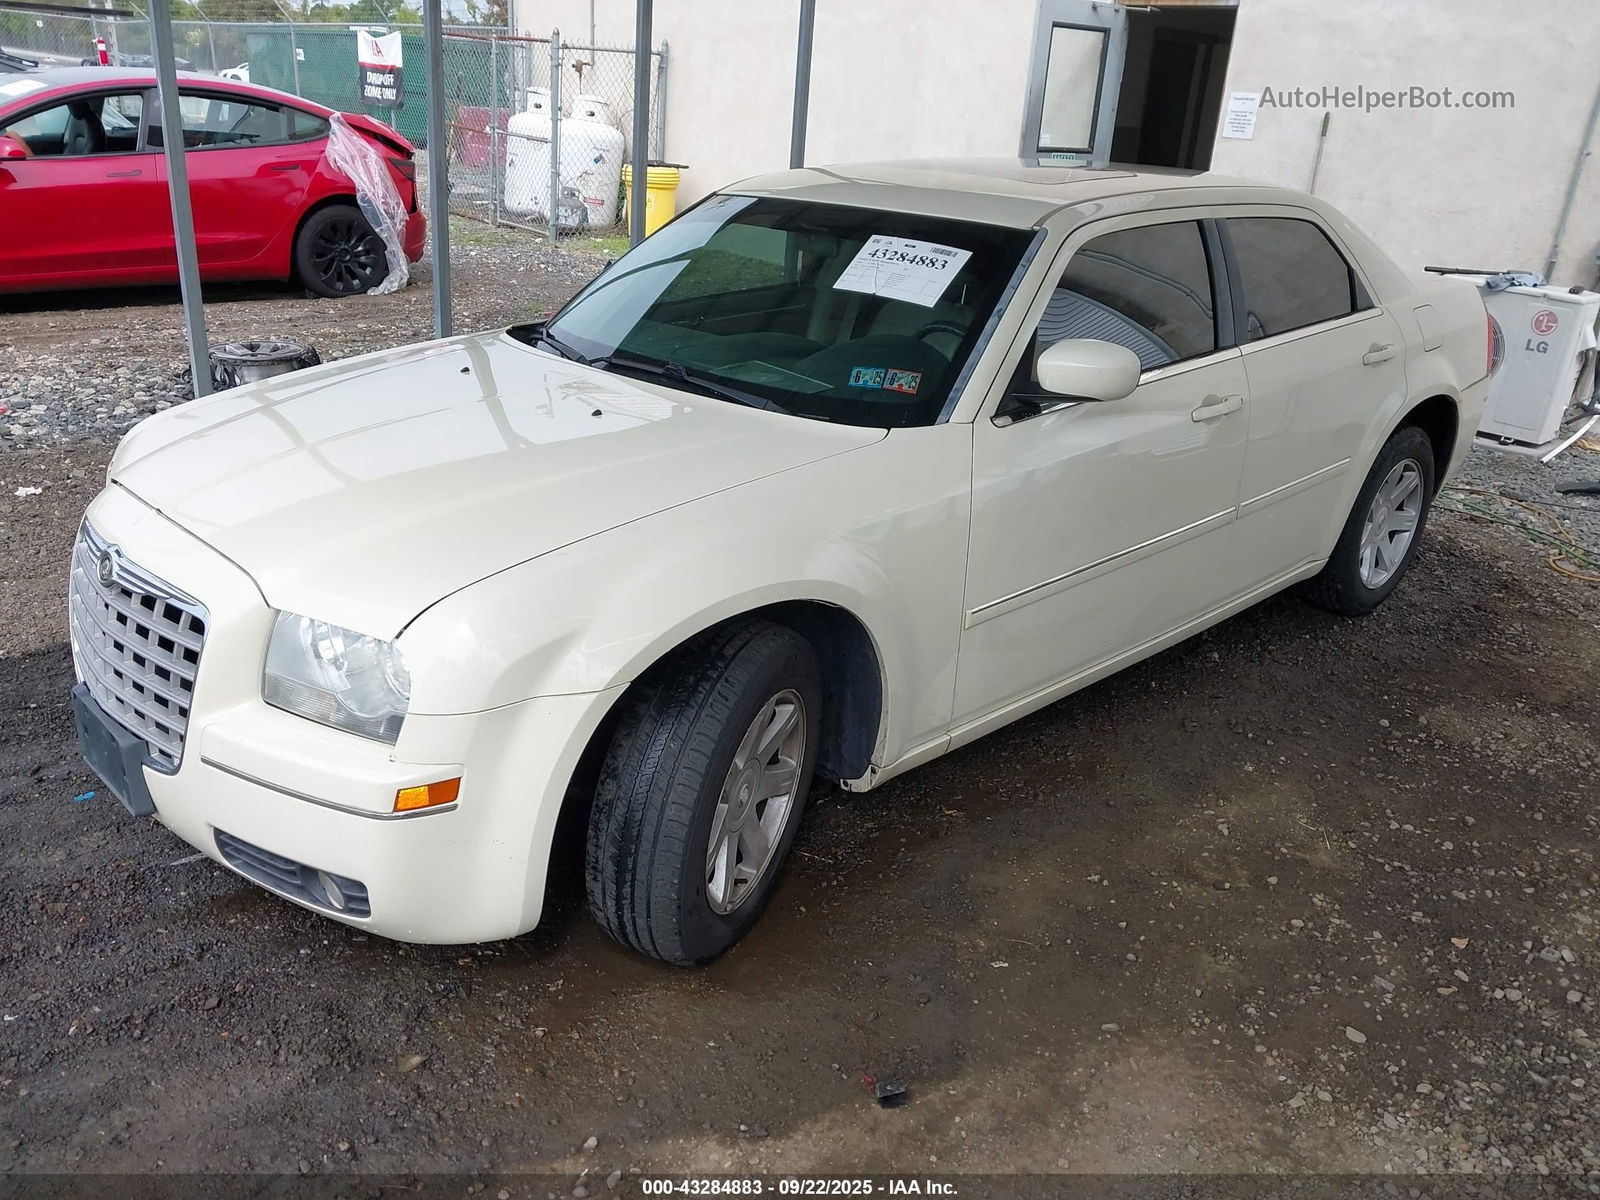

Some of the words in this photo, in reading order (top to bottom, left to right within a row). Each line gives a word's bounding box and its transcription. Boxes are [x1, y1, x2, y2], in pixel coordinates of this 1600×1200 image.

[364, 84, 382, 99] ZONE
[382, 87, 397, 100] ONLY
[868, 248, 948, 270] 43284883
[1525, 338, 1549, 354] LG
[854, 370, 862, 383] 6
[889, 372, 898, 386] 6
